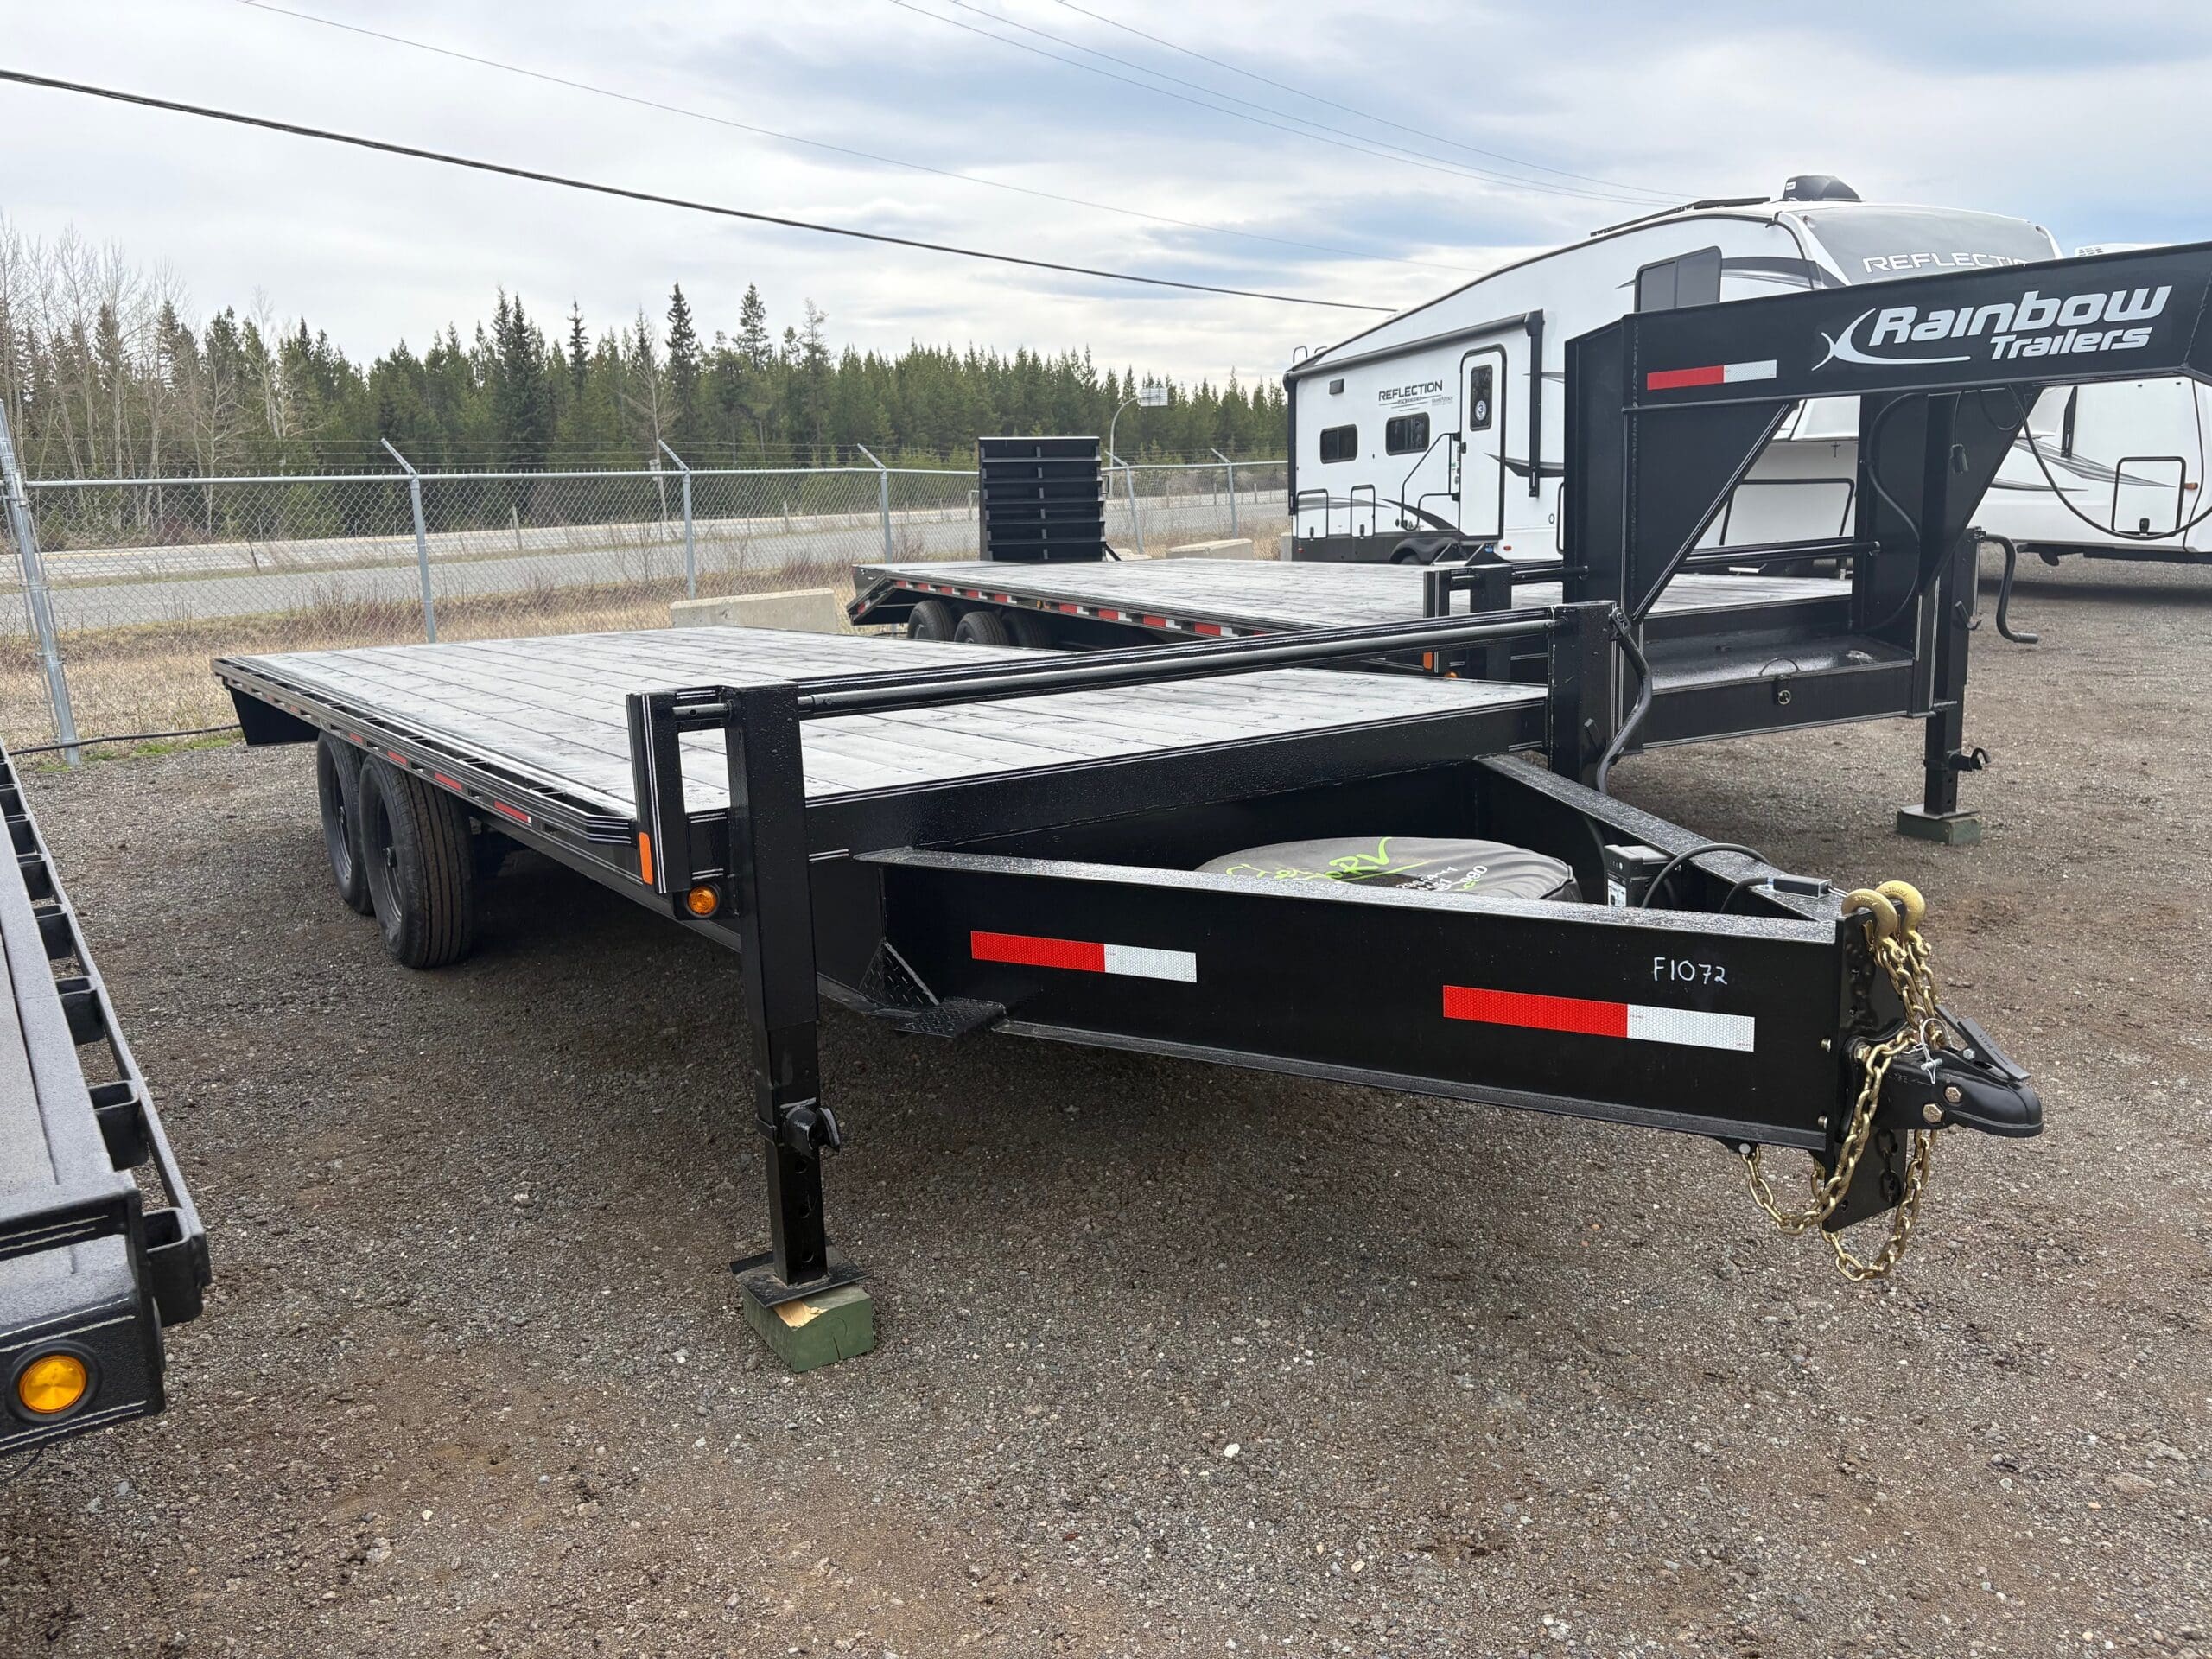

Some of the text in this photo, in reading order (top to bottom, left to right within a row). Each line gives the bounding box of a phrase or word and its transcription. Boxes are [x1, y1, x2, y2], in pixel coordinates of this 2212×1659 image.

[1868, 285, 2173, 346] Rainbow
[1989, 327, 2153, 360] Trailers
[1378, 379, 1443, 401] REFLECTION
[1653, 957, 1728, 985] F1072
